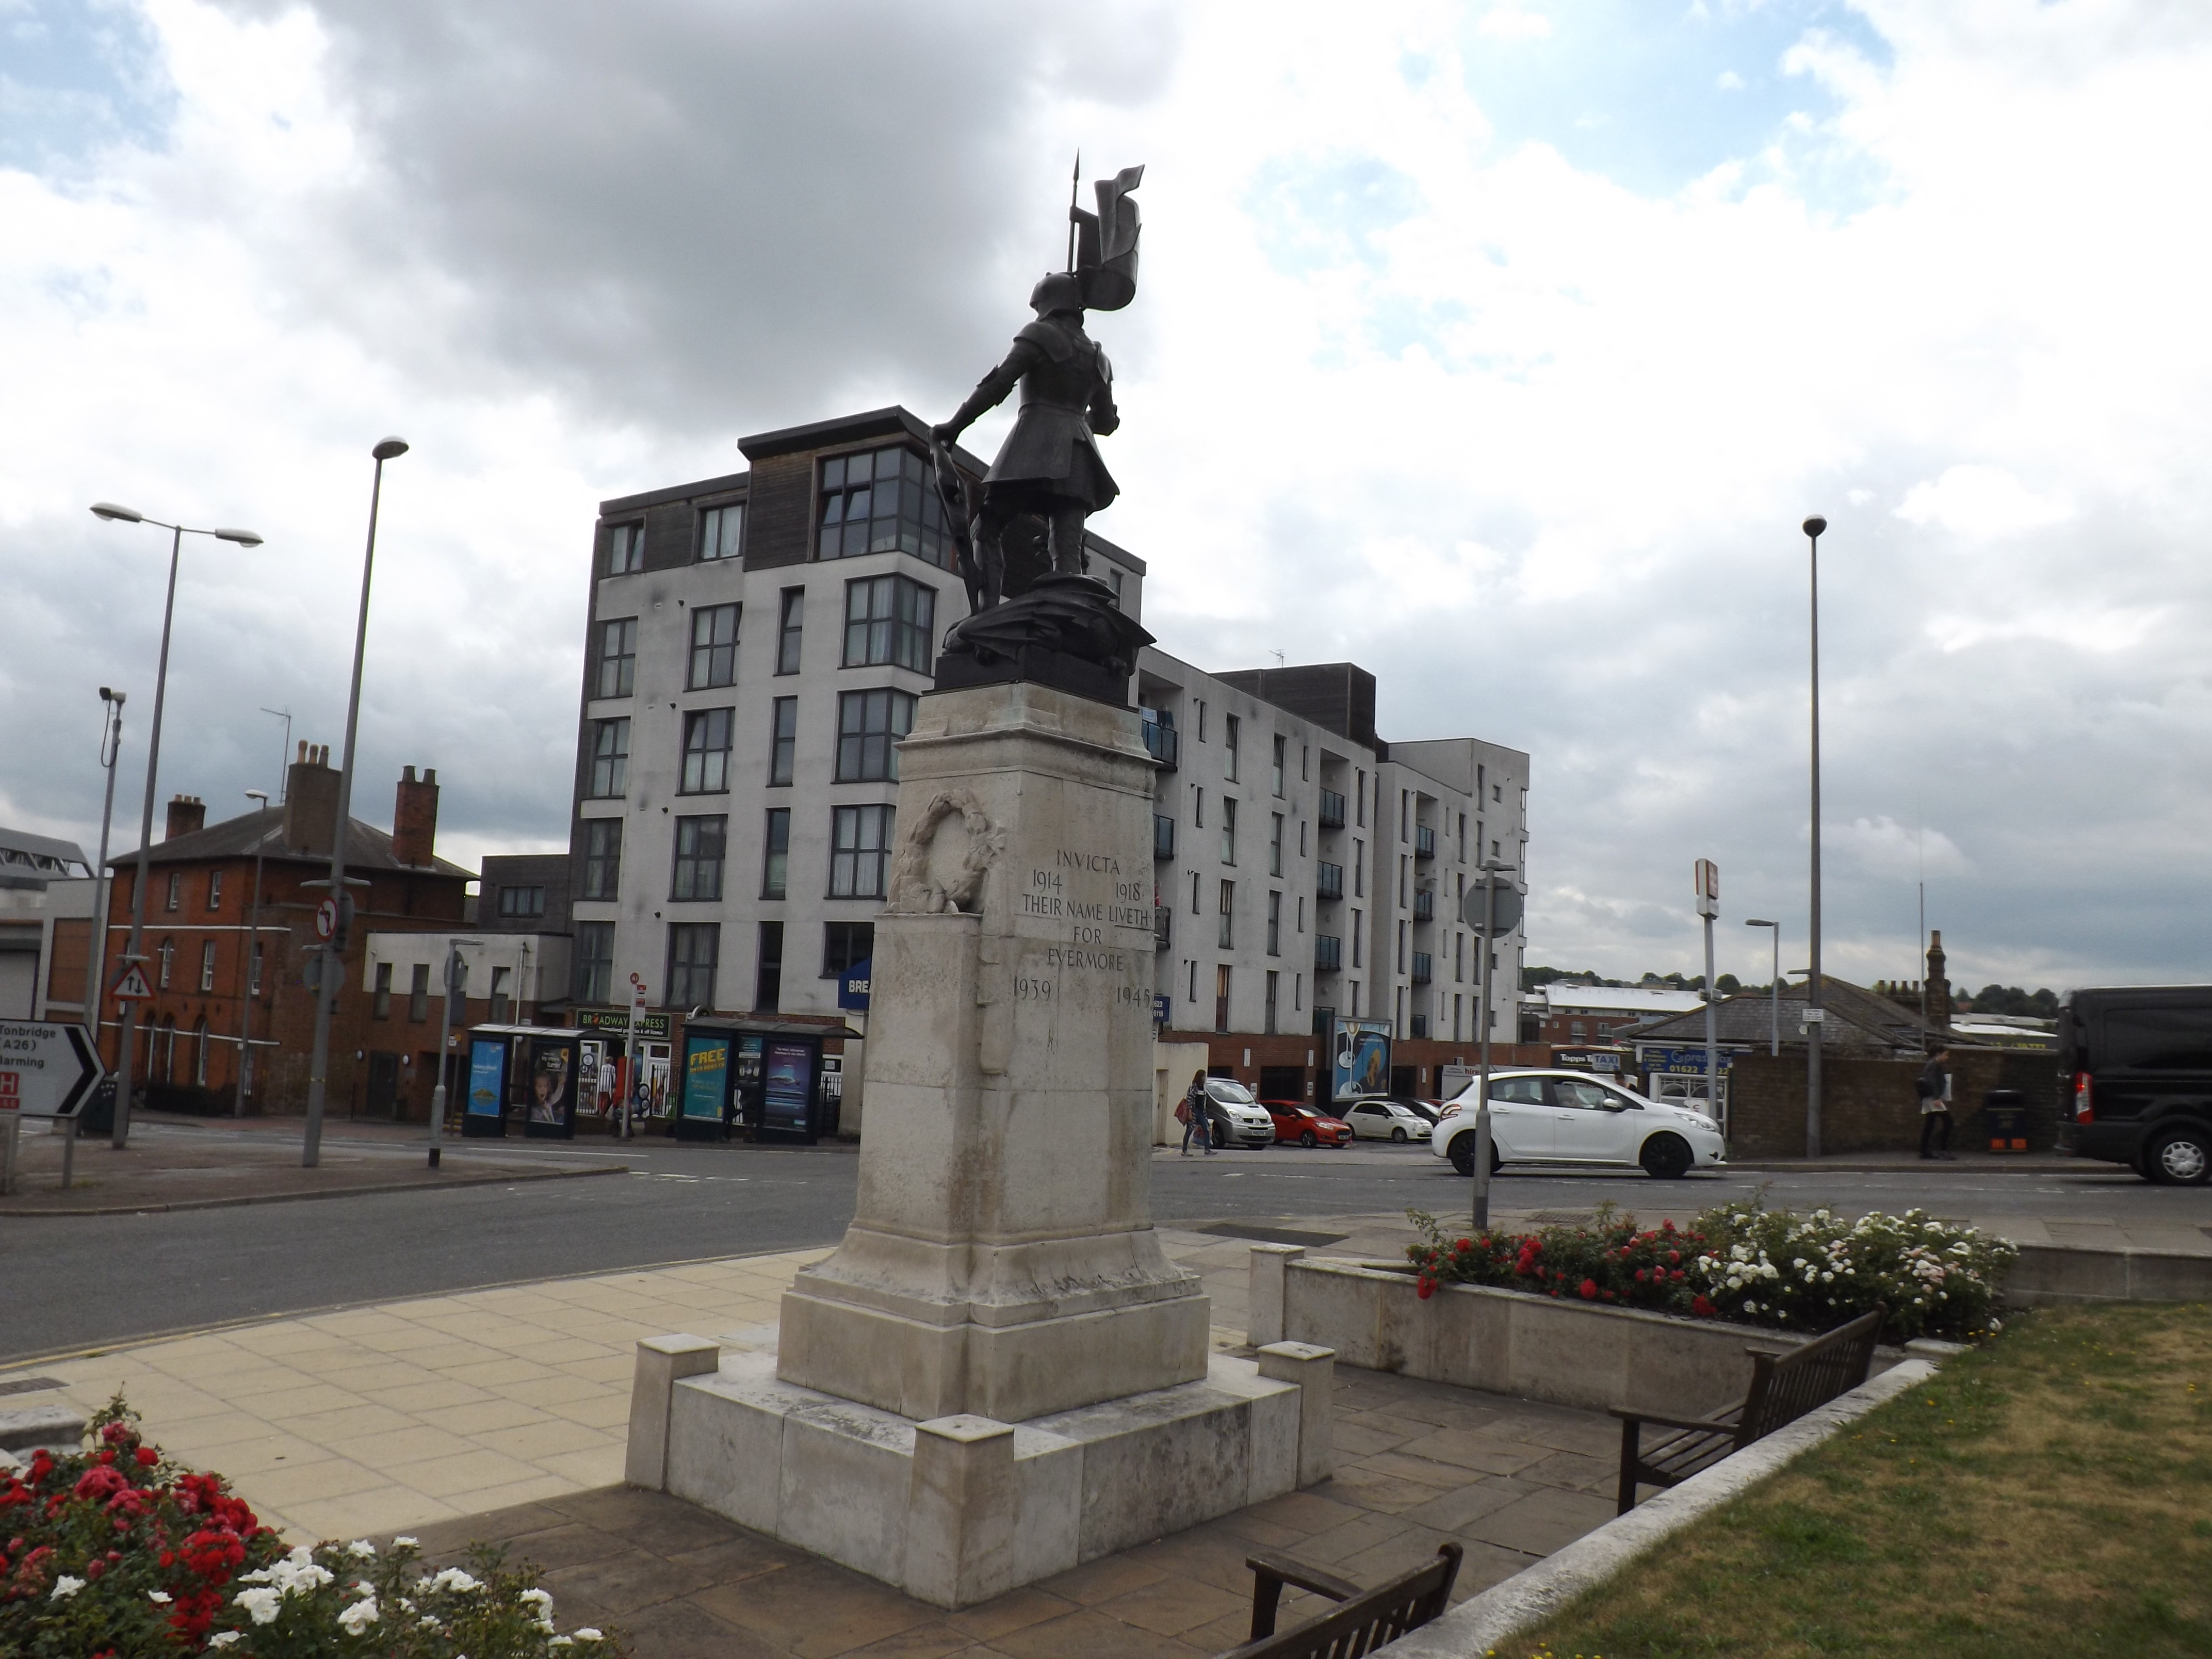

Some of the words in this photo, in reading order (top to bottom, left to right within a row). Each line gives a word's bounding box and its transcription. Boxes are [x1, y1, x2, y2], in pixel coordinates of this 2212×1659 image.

[1057, 850, 1120, 875] INVICTA
[1033, 869, 1062, 894] 1914
[1116, 882, 1141, 903] 1918
[1022, 893, 1062, 916] THEIR
[1067, 901, 1102, 921] NAME
[1109, 905, 1148, 926] LIVETH
[1074, 926, 1101, 945] FOR
[1048, 948, 1123, 971] EVERMORE
[1014, 975, 1051, 1001] 1939
[1117, 986, 1151, 1007] 1945
[582, 1013, 629, 1026] BROADWAY
[635, 1018, 664, 1028] XPRESS
[0, 1025, 56, 1039] Tonbridge
[0, 1039, 36, 1051] A26)
[690, 1048, 726, 1066] FREE
[1559, 1053, 1586, 1063] Topps
[1595, 1055, 1618, 1064] TAXI
[1669, 1064, 1698, 1074] 01622
[1, 1074, 15, 1093] H
